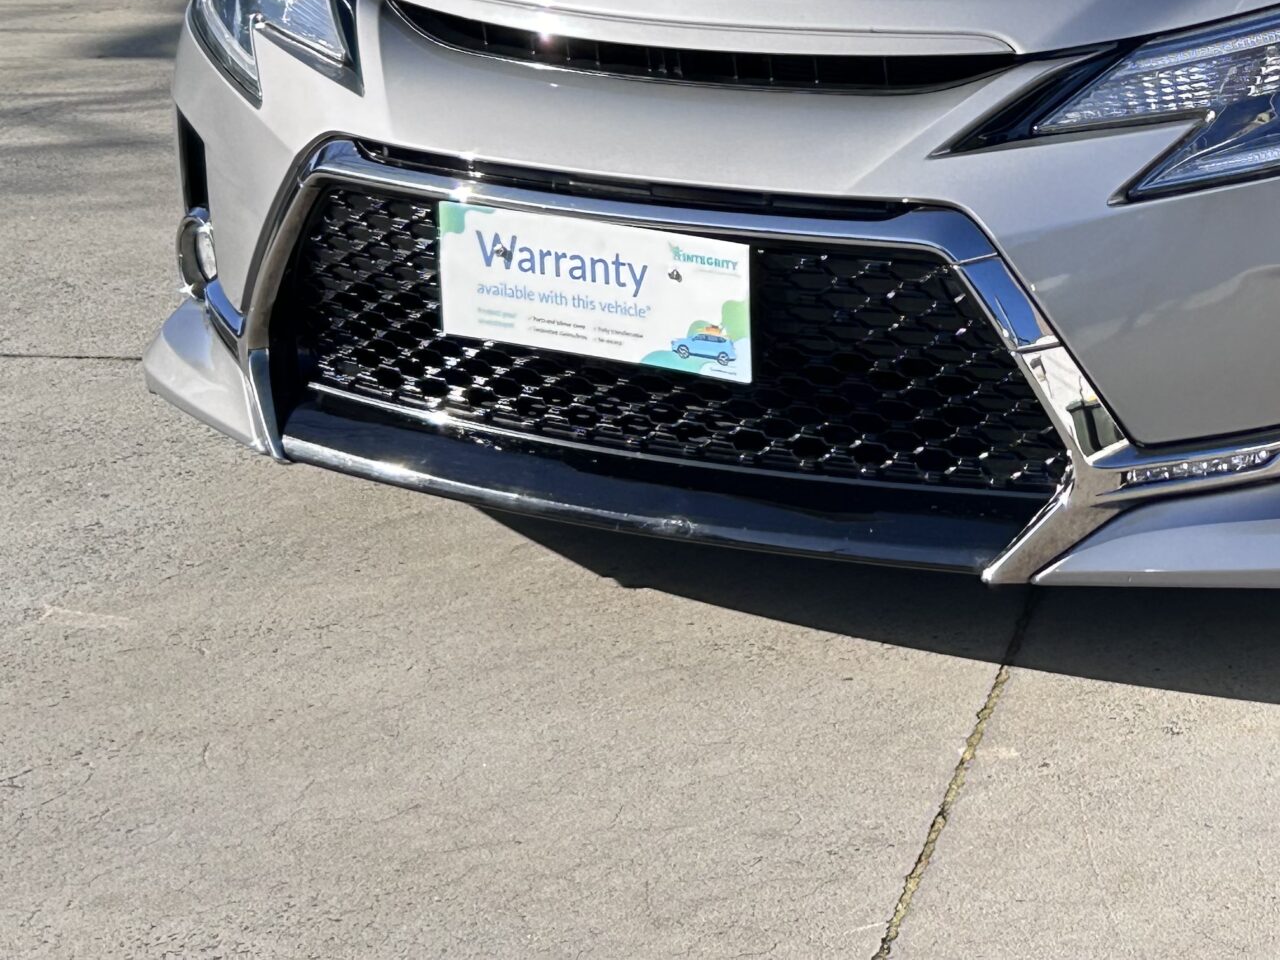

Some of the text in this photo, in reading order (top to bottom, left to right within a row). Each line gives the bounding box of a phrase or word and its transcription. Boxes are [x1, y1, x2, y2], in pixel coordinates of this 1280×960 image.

[475, 229, 648, 298] Warranty
[681, 252, 738, 271] INTEGRITY
[477, 282, 535, 301] available
[538, 290, 568, 308] with
[572, 294, 596, 311] this
